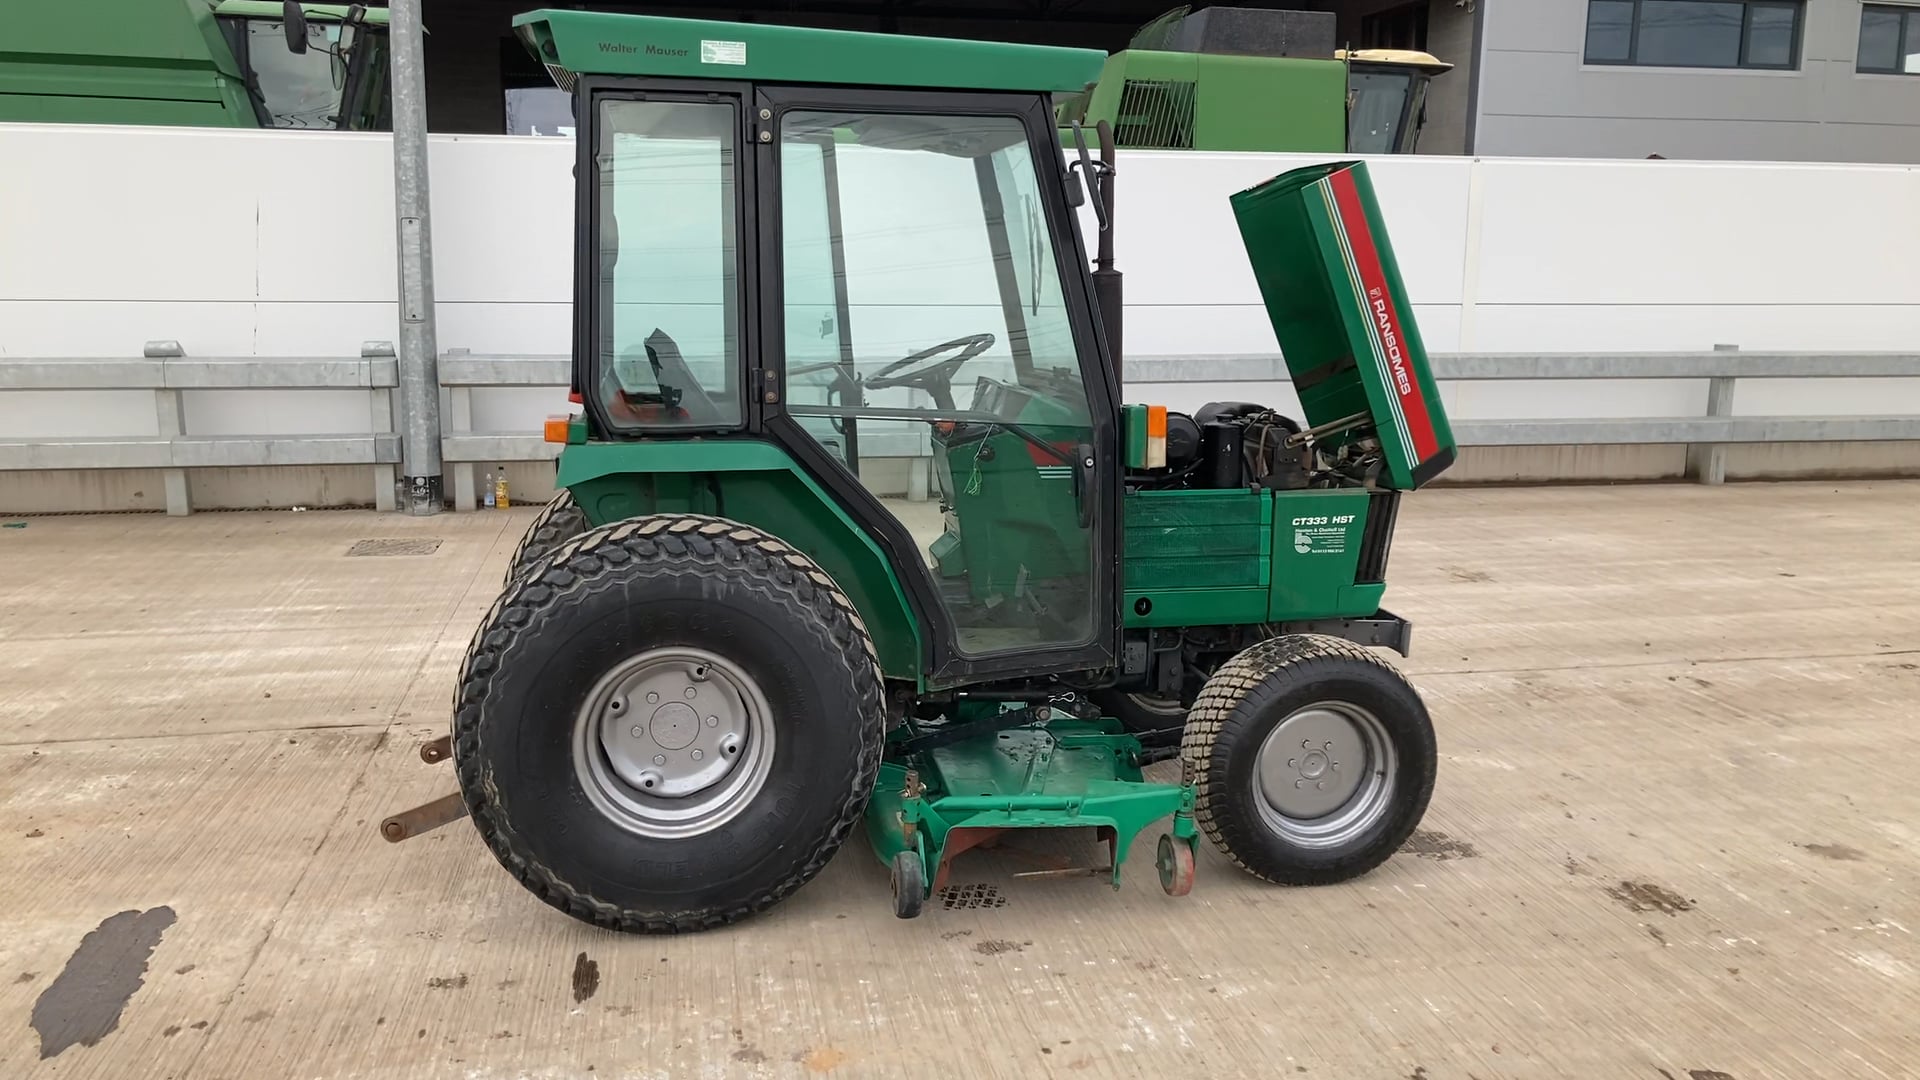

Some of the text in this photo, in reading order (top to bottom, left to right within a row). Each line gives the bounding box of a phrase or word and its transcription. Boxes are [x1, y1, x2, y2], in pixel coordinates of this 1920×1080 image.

[598, 42, 637, 54] Walter
[645, 44, 689, 57] Mauser
[1373, 299, 1411, 395] RANSOMES
[1292, 515, 1355, 526] CT333 HST
